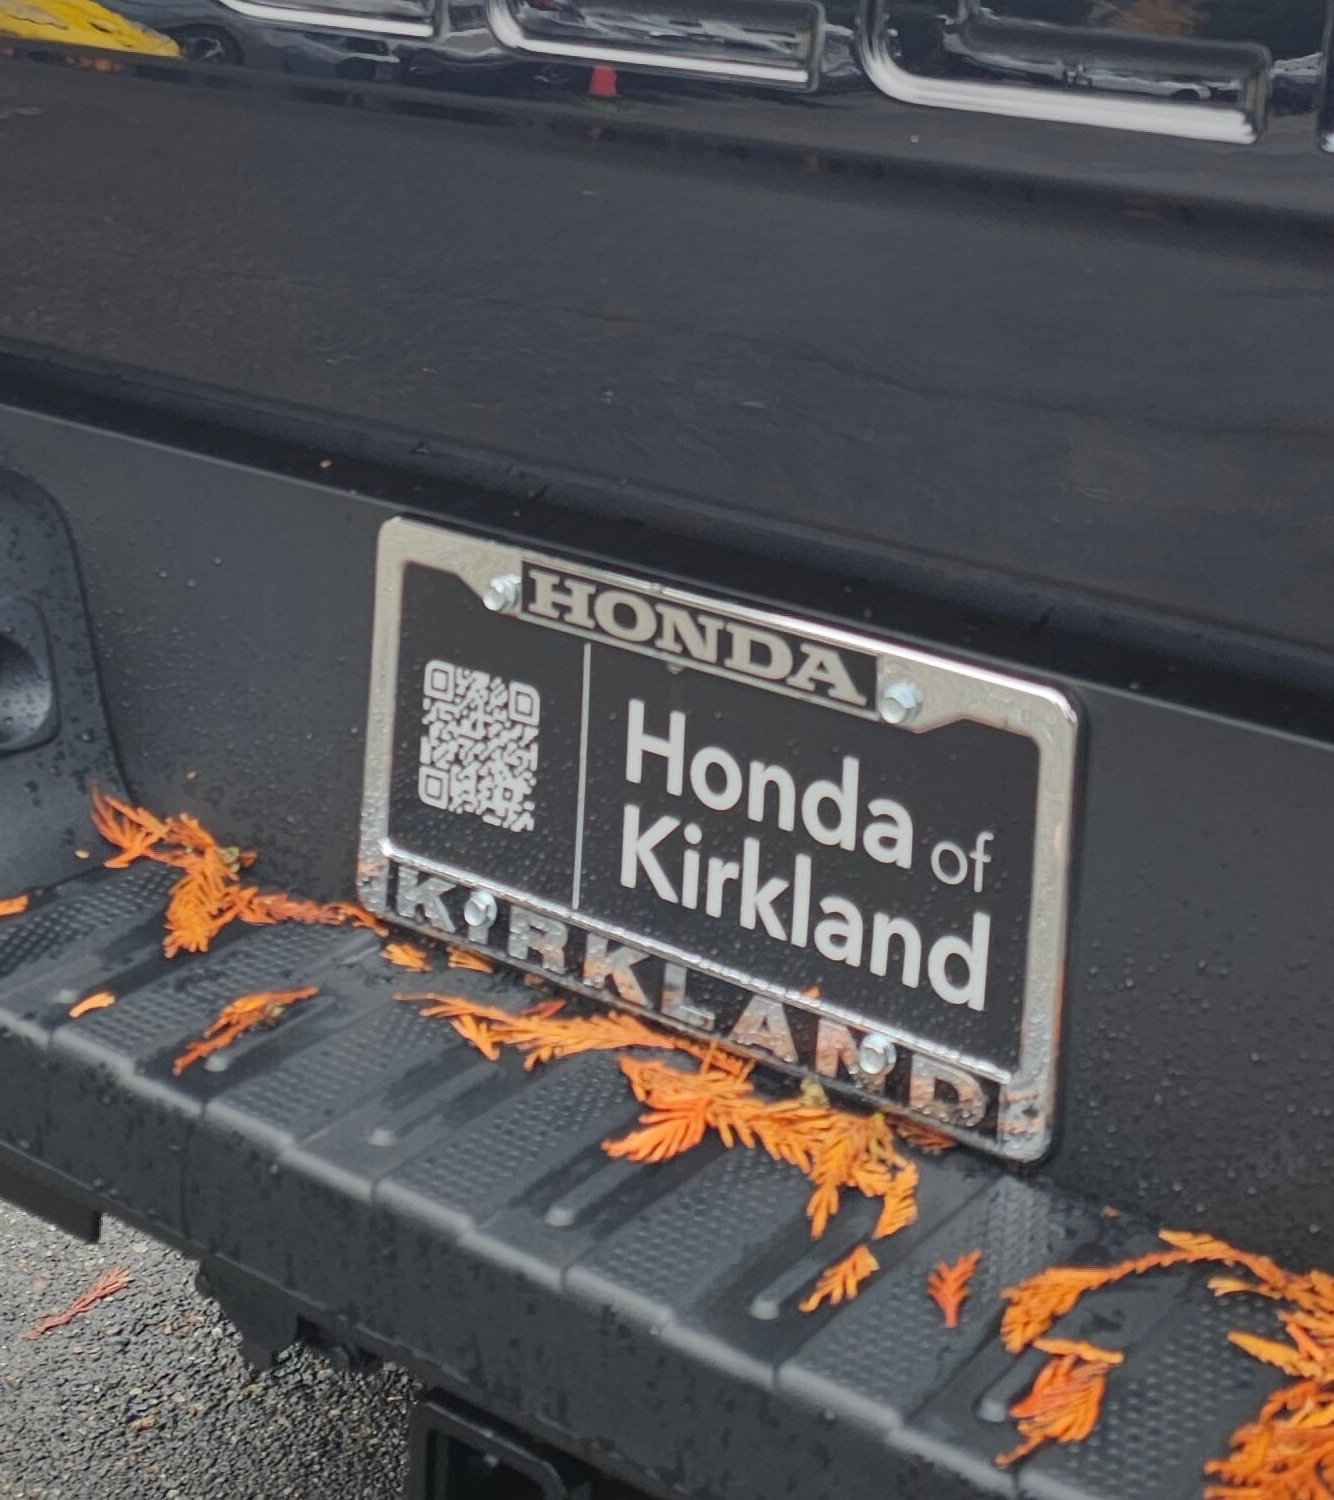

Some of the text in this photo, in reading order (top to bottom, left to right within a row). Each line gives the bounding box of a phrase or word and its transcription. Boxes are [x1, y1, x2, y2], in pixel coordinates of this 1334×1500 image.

[524, 567, 867, 706] HONDA
[624, 699, 993, 893] Honda of
[620, 804, 991, 1011] Kirkland
